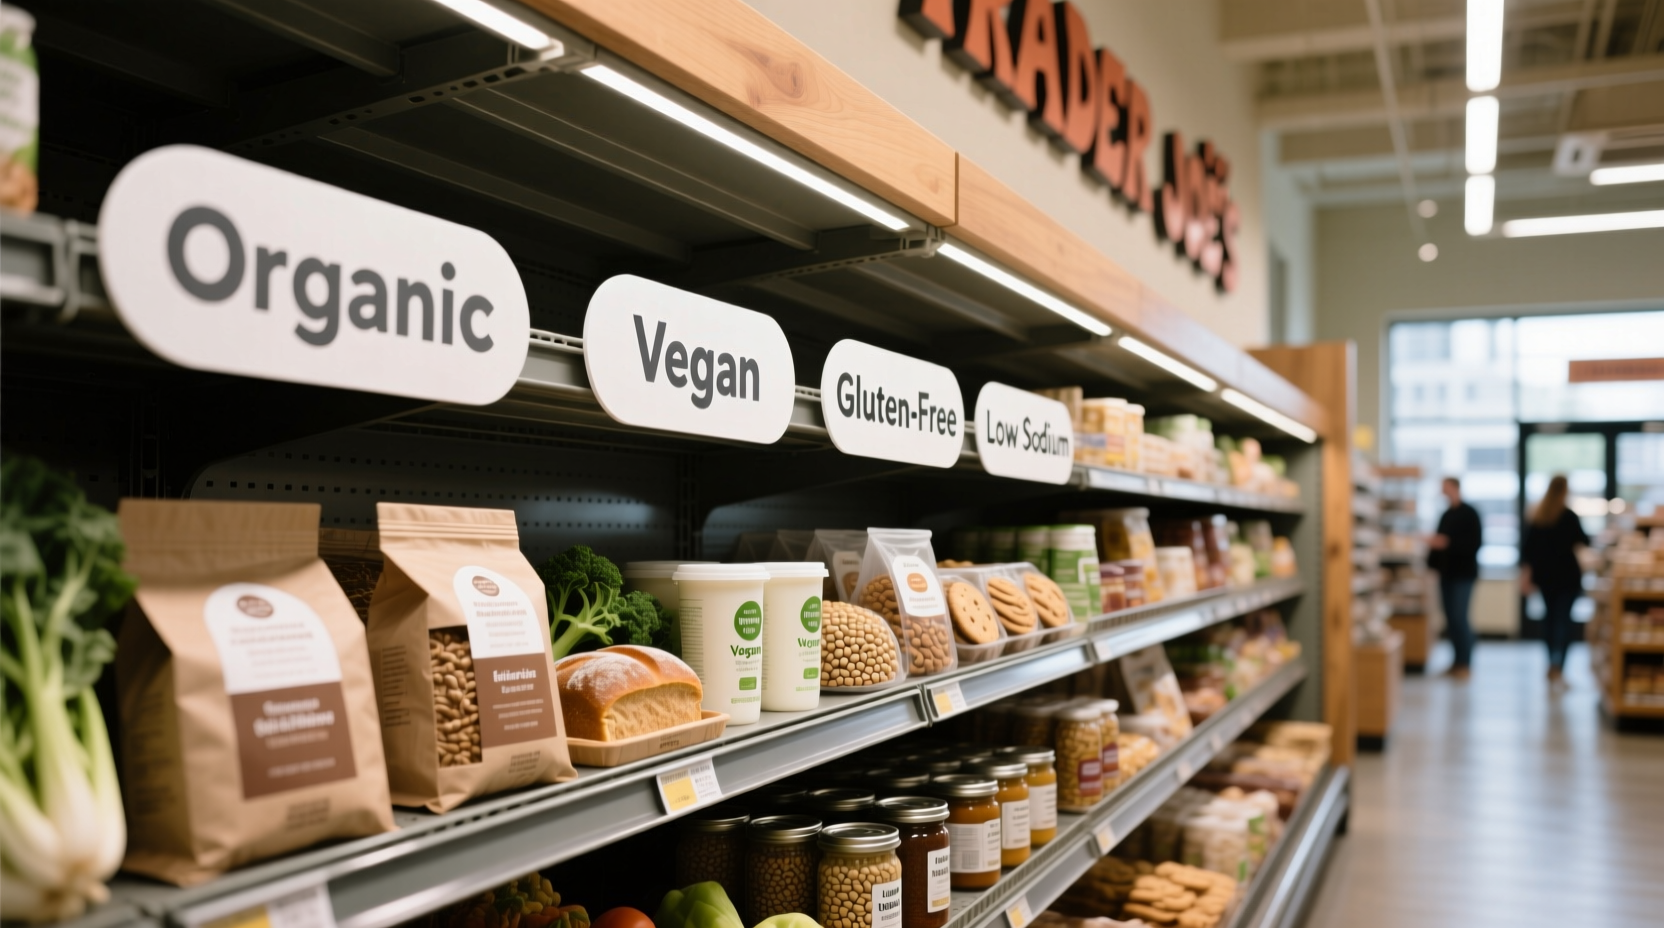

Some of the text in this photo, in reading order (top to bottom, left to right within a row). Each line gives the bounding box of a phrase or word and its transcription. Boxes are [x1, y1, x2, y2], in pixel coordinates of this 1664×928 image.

[167, 204, 495, 354] Organic
[633, 314, 760, 409] Vegan
[836, 372, 958, 437] Gluten-Free
[987, 410, 1018, 448] Low
